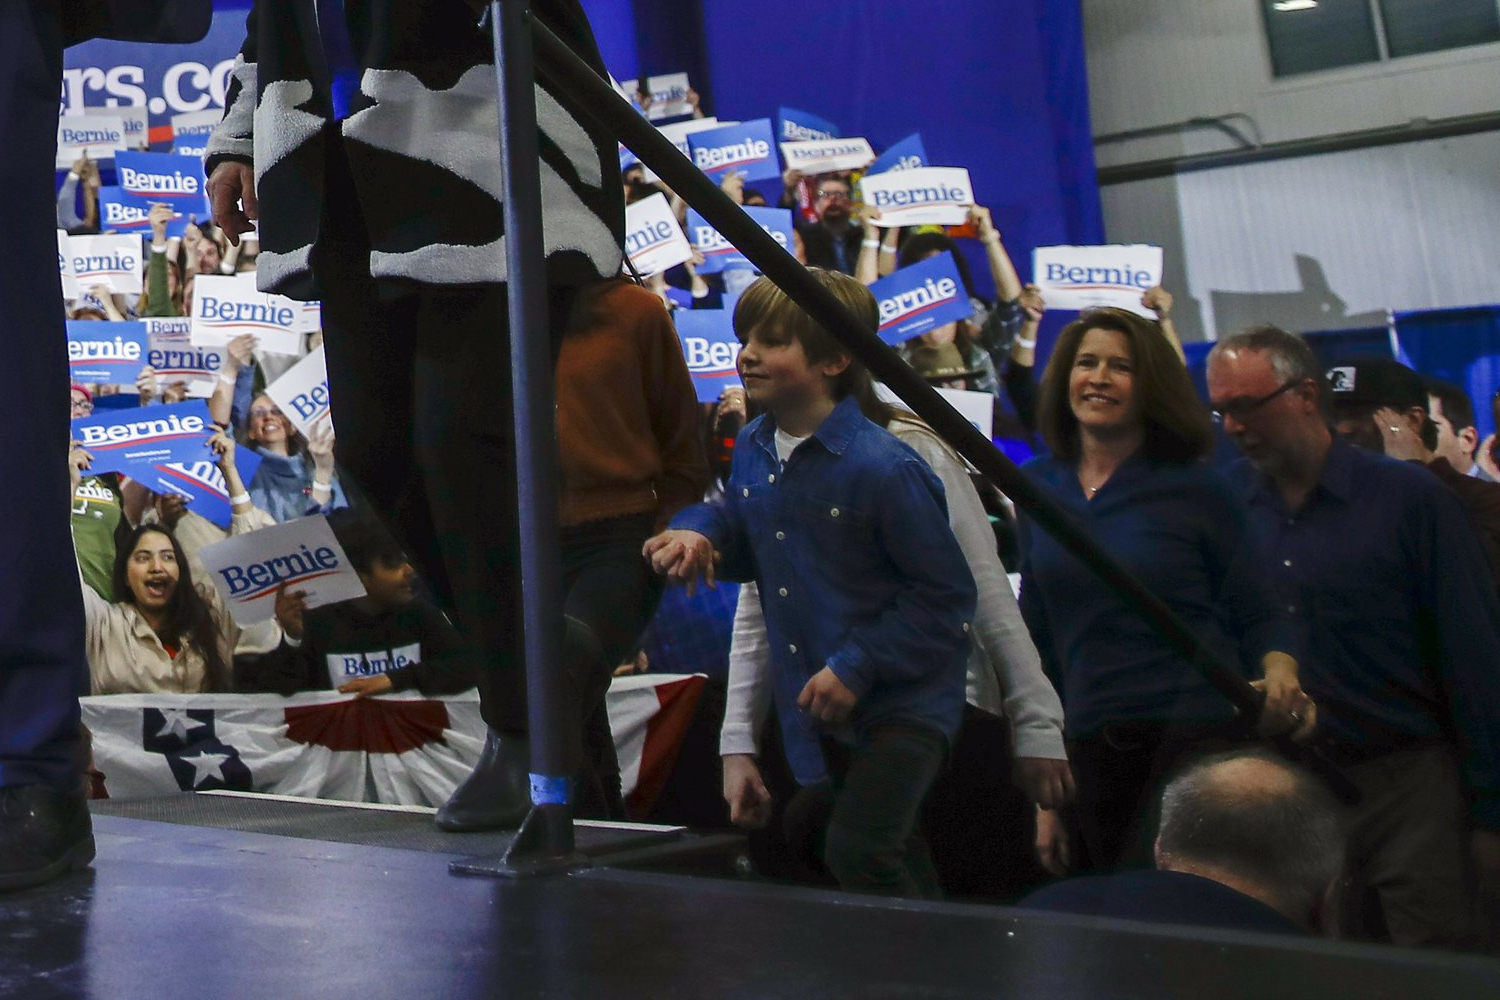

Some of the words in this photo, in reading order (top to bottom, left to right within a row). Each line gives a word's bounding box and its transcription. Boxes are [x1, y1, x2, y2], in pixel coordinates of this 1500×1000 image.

[61, 60, 234, 116] rs.c
[62, 126, 121, 143] Bernie
[694, 138, 769, 165] Bernie
[121, 167, 198, 193] Bernie
[873, 184, 965, 206] Bernie
[105, 202, 149, 223] Ber
[626, 221, 673, 254] rnie
[74, 251, 135, 272] ernie
[1046, 263, 1151, 288] Bernie
[880, 276, 957, 319] ernie
[200, 297, 294, 326] Bernie
[152, 321, 189, 334] Bern
[68, 336, 141, 359] ernie
[148, 347, 220, 370] ernie
[685, 338, 742, 367] Ber
[80, 414, 204, 443] Bernie
[219, 544, 339, 595] Bernie
